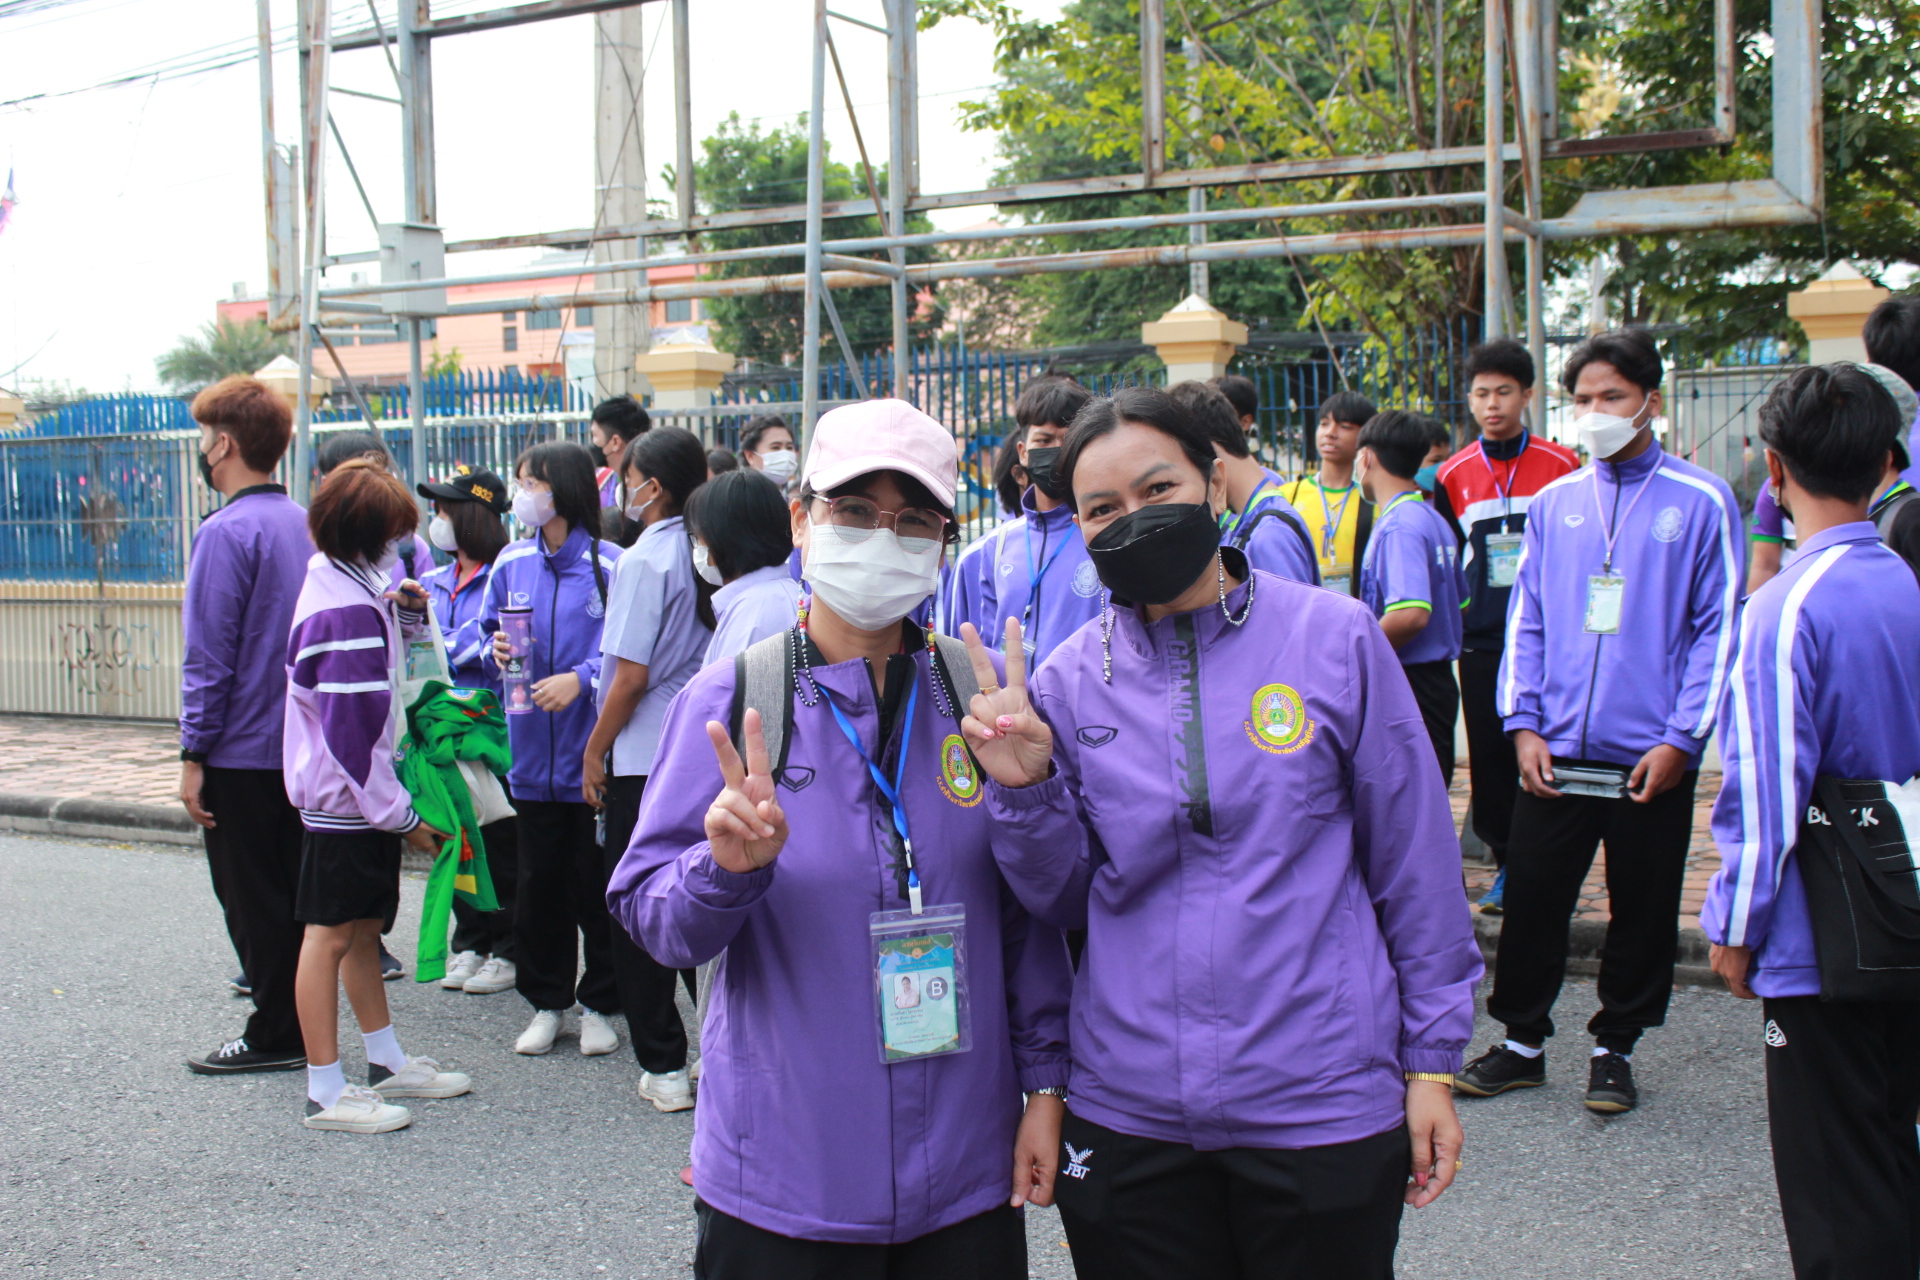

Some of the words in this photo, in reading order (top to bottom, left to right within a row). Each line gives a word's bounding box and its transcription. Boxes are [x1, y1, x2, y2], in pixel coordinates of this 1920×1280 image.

[470, 483, 494, 503] 1932
[1166, 638, 1195, 723] GRAND
[1807, 805, 1879, 827] BLK
[931, 981, 943, 997] B
